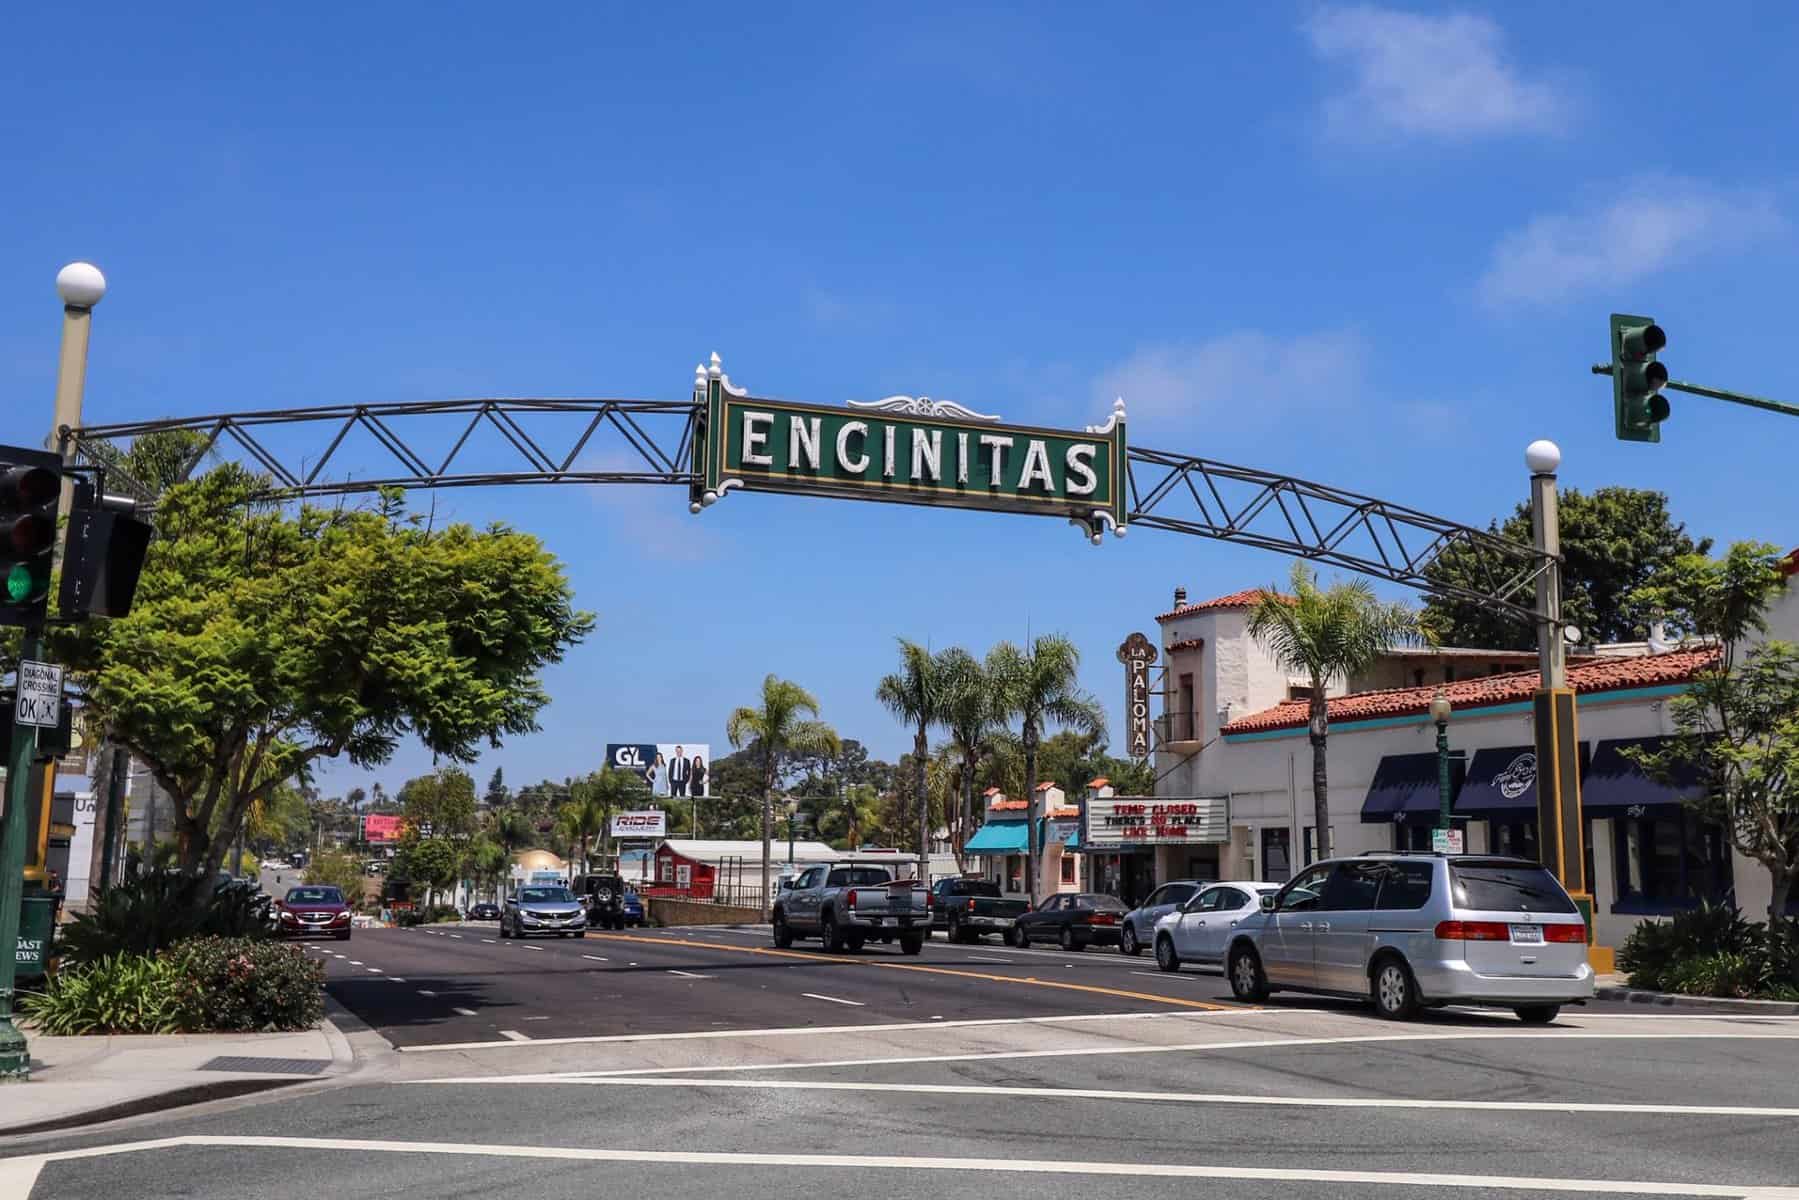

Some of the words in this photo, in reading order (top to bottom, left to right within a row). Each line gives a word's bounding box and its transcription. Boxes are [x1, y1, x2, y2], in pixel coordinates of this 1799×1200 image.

[742, 411, 1098, 495] ENCINITAS
[1131, 647, 1146, 657] LA
[24, 668, 57, 681] DIAGONAL
[23, 680, 57, 693] CROSSING
[20, 698, 36, 719] OK
[1133, 660, 1146, 746] PALOMA
[615, 747, 645, 766] GYL
[1113, 804, 1146, 815] TEMP
[1152, 804, 1197, 815] CLOSED
[616, 816, 660, 826] RIDE
[1105, 816, 1145, 825] THERE'S
[1171, 816, 1201, 825] PLACE
[16, 951, 40, 960] EWS
